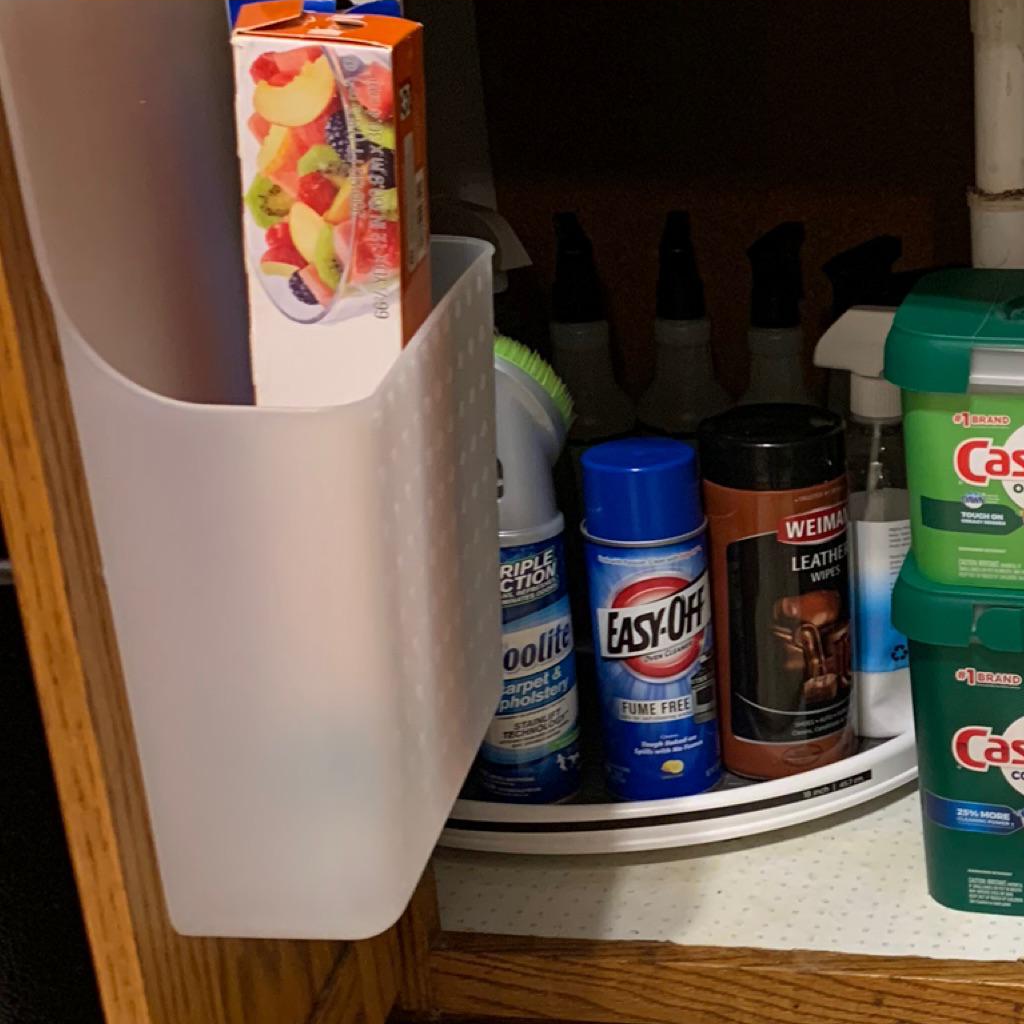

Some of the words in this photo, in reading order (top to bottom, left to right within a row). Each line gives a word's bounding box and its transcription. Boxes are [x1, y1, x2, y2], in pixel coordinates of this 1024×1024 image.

[952, 412, 970, 428] #1
[971, 414, 1011, 425] BRAND
[961, 511, 989, 520] TOUGH
[990, 512, 1004, 521] ON
[500, 549, 554, 578] RIPLE
[500, 562, 557, 593] CTION
[810, 565, 841, 584] WIPES
[607, 585, 705, 654] EASY-OFF
[503, 623, 569, 671] oolite
[955, 668, 975, 685] #1
[976, 673, 1022, 685] BRAND
[500, 677, 568, 713] pholstery
[621, 702, 656, 716] FUME
[661, 697, 690, 714] FREE
[956, 807, 979, 817] 25%
[980, 809, 1010, 820] MORE
